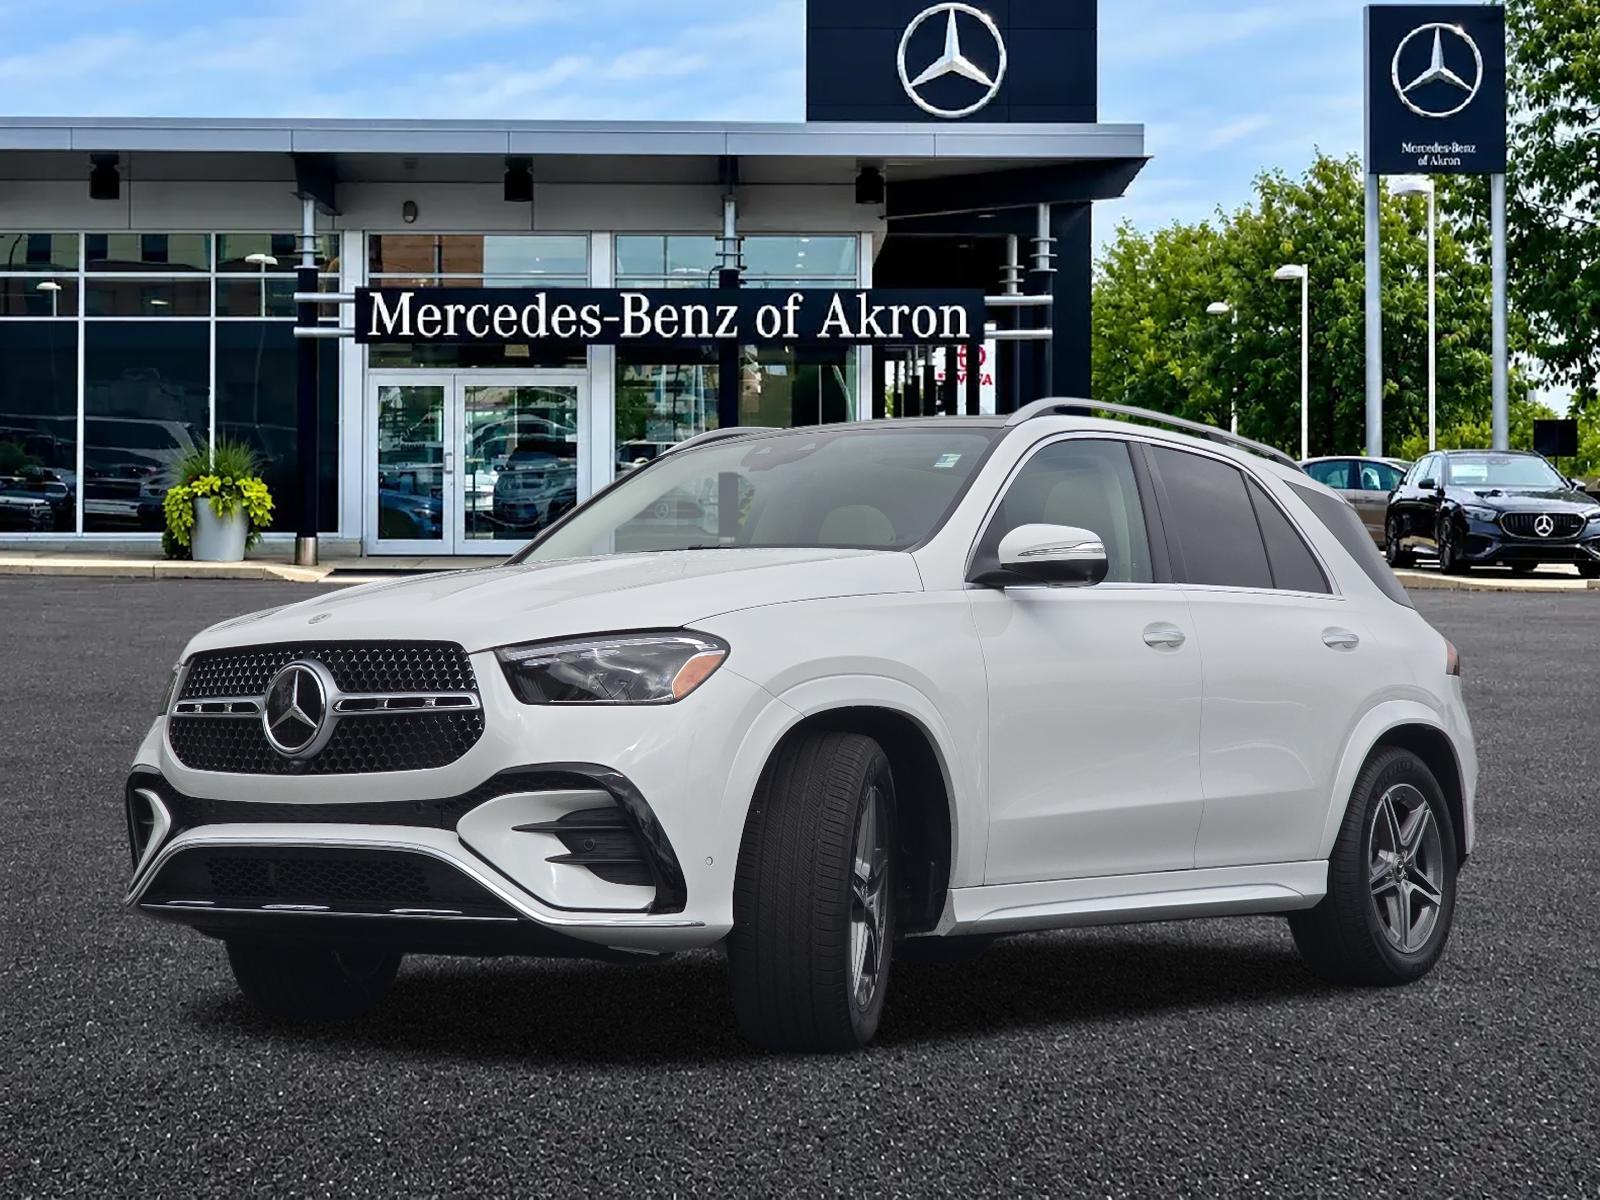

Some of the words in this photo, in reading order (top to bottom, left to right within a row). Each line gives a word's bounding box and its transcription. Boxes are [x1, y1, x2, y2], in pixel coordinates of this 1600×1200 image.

[1401, 142, 1476, 154] Mercedes-Benz
[1417, 154, 1429, 166] of
[1430, 154, 1461, 166] Akron
[367, 291, 738, 338] Mercedes-Benz
[755, 292, 804, 338] of
[817, 292, 970, 338] Akron
